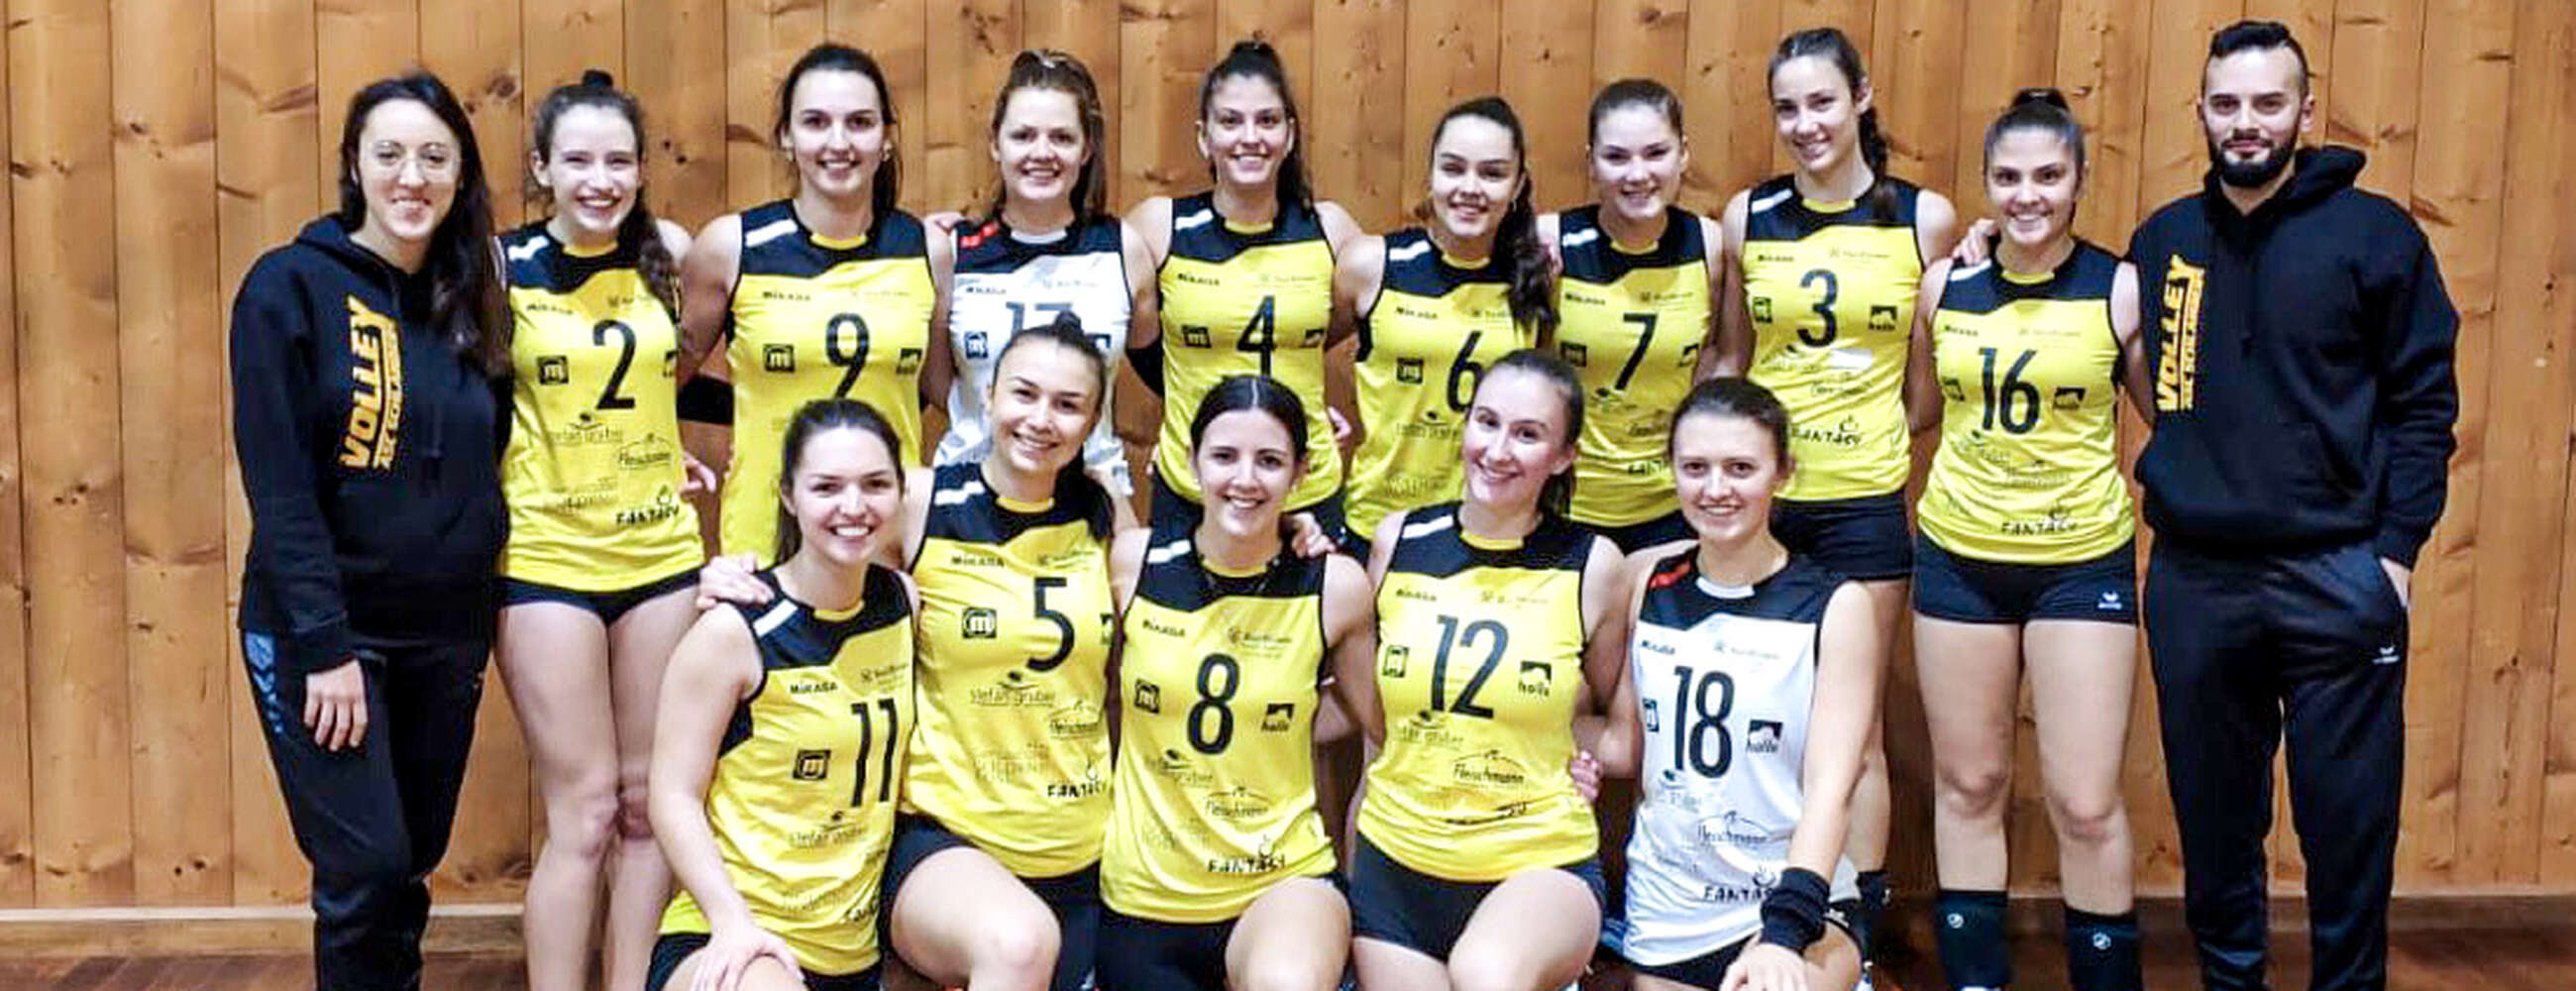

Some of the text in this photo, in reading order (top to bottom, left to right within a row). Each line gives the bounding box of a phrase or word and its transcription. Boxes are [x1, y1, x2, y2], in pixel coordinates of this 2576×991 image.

[826, 312, 869, 398] 9
[1236, 295, 1276, 377] 4
[1623, 312, 1659, 390] 7
[1796, 269, 1840, 348] 3
[2156, 254, 2205, 411] VOLLEY
[339, 294, 396, 469] VOLLEY
[592, 319, 637, 410] 2
[1447, 330, 1484, 413] 6
[1979, 347, 2041, 435] 16
[1026, 577, 1075, 673] 5
[1431, 613, 1509, 720] 12
[1187, 652, 1240, 756] 8
[1673, 665, 1735, 779] 18
[850, 698, 899, 809] 11
